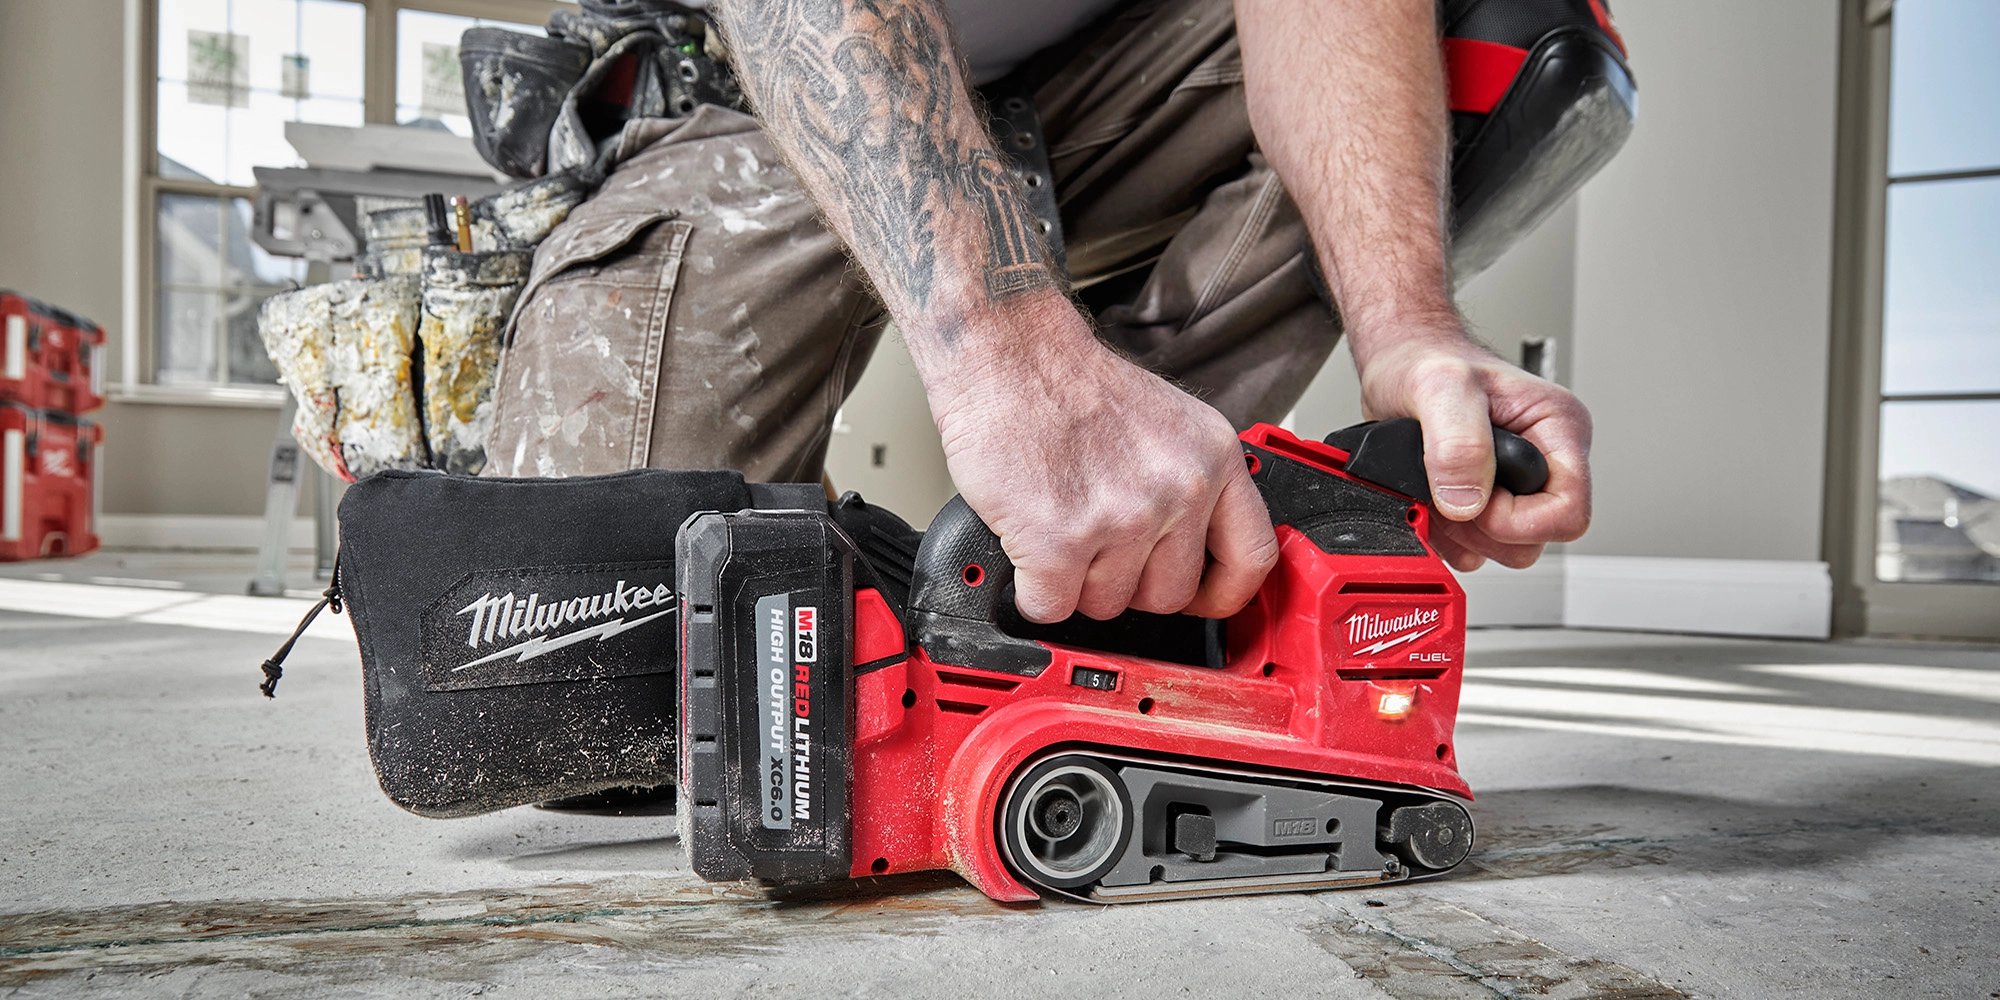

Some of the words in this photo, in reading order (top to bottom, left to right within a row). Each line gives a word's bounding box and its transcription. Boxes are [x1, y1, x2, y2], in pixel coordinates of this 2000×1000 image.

[455, 580, 675, 649] Milwaukee
[770, 608, 784, 663] HIGH
[798, 610, 813, 659] M18
[1344, 607, 1440, 645] Milwaukee
[1092, 673, 1100, 687] 5
[1409, 652, 1452, 662] FUEL
[770, 668, 784, 753] OUTPUT
[795, 663, 810, 820] REDLITHIUM
[770, 756, 784, 822] XC6.0
[1275, 820, 1315, 836] M18
